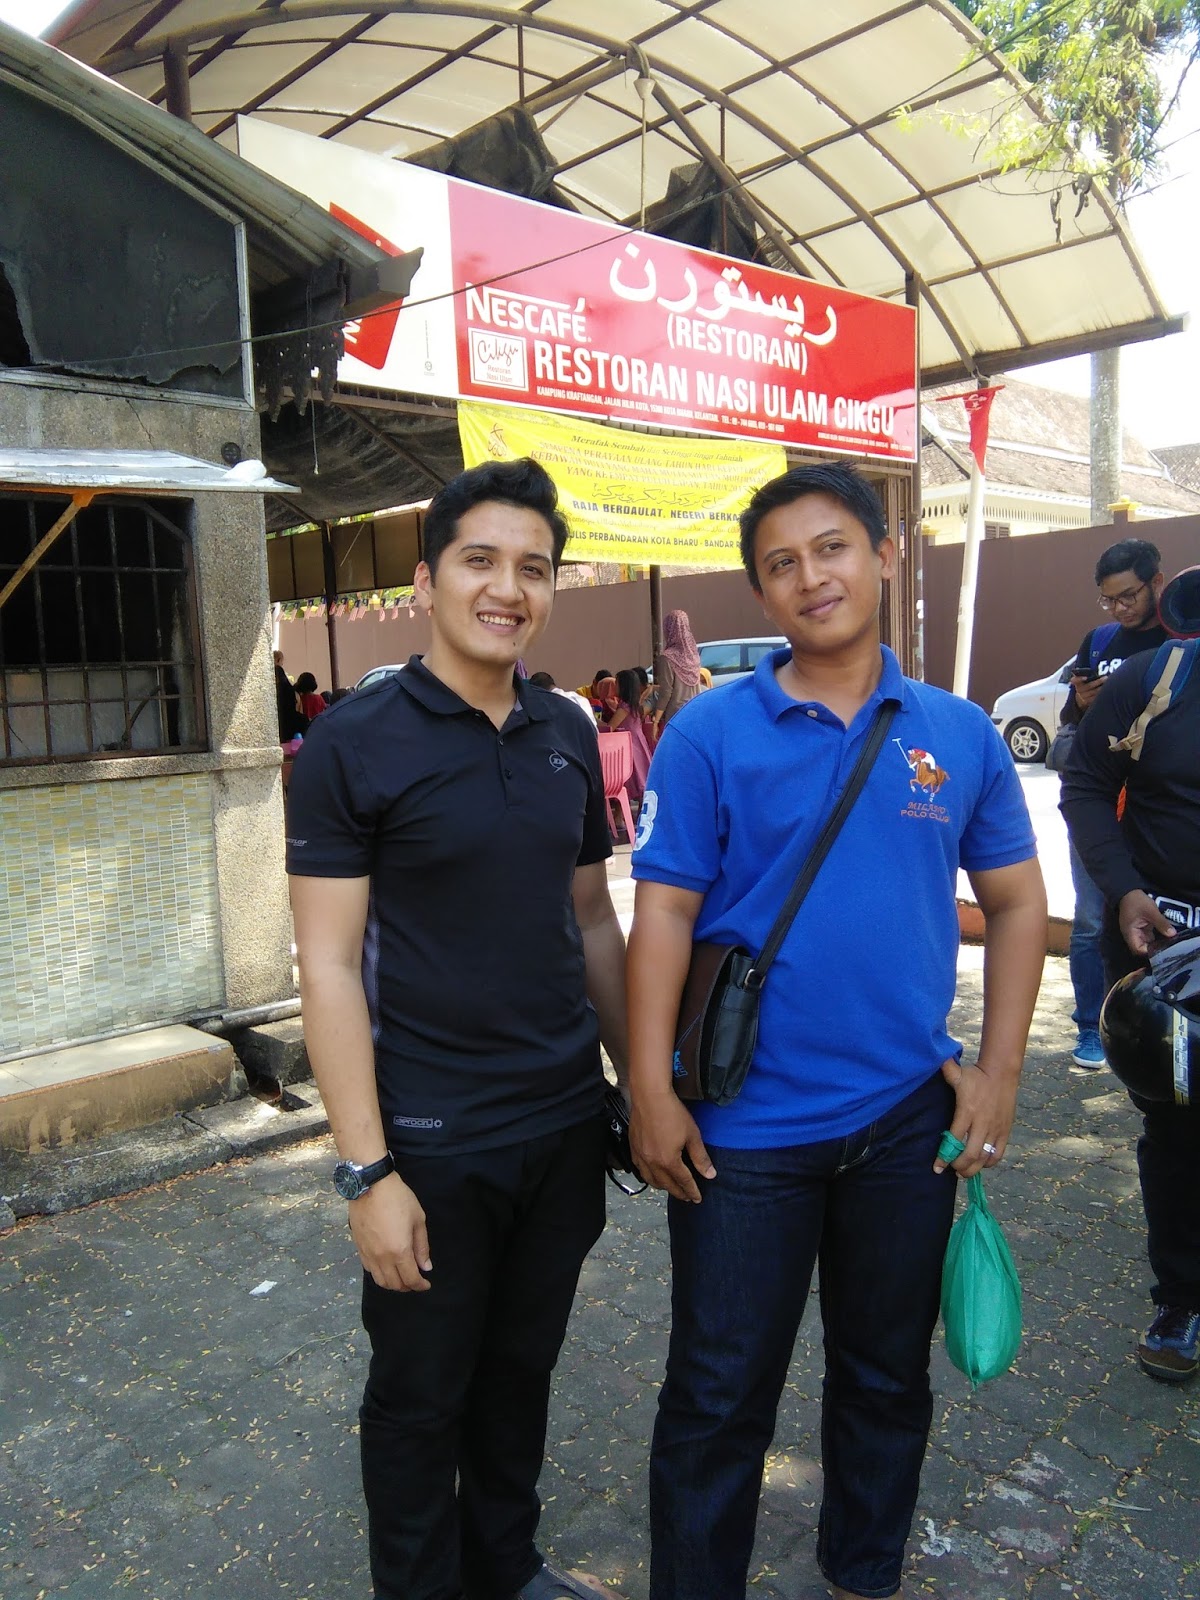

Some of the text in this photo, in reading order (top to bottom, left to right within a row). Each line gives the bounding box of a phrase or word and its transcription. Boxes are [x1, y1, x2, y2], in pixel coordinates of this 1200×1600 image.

[609, 242, 837, 346] ريستورن
[666, 313, 808, 375] (RESTORAN)
[533, 340, 895, 437] RESTORAN NASI ULAM CIKGU
[536, 385, 566, 400] KAMPUNG
[604, 396, 621, 408] JALAN
[571, 435, 609, 448] Merafak
[612, 441, 646, 453] Sembah
[584, 449, 632, 463] PERAYAAN
[634, 456, 662, 467] ULANG
[664, 459, 693, 470] TAHUN
[566, 466, 593, 478] YANG
[572, 500, 599, 512] RAJA
[670, 509, 706, 519] NEGERI
[709, 512, 741, 522] BERKA
[589, 532, 649, 544] PERBANDARAN
[651, 536, 671, 546] KOTA
[673, 538, 699, 547] BHARU
[704, 540, 734, 548] BANDAR
[900, 809, 949, 823] POLO CLUB
